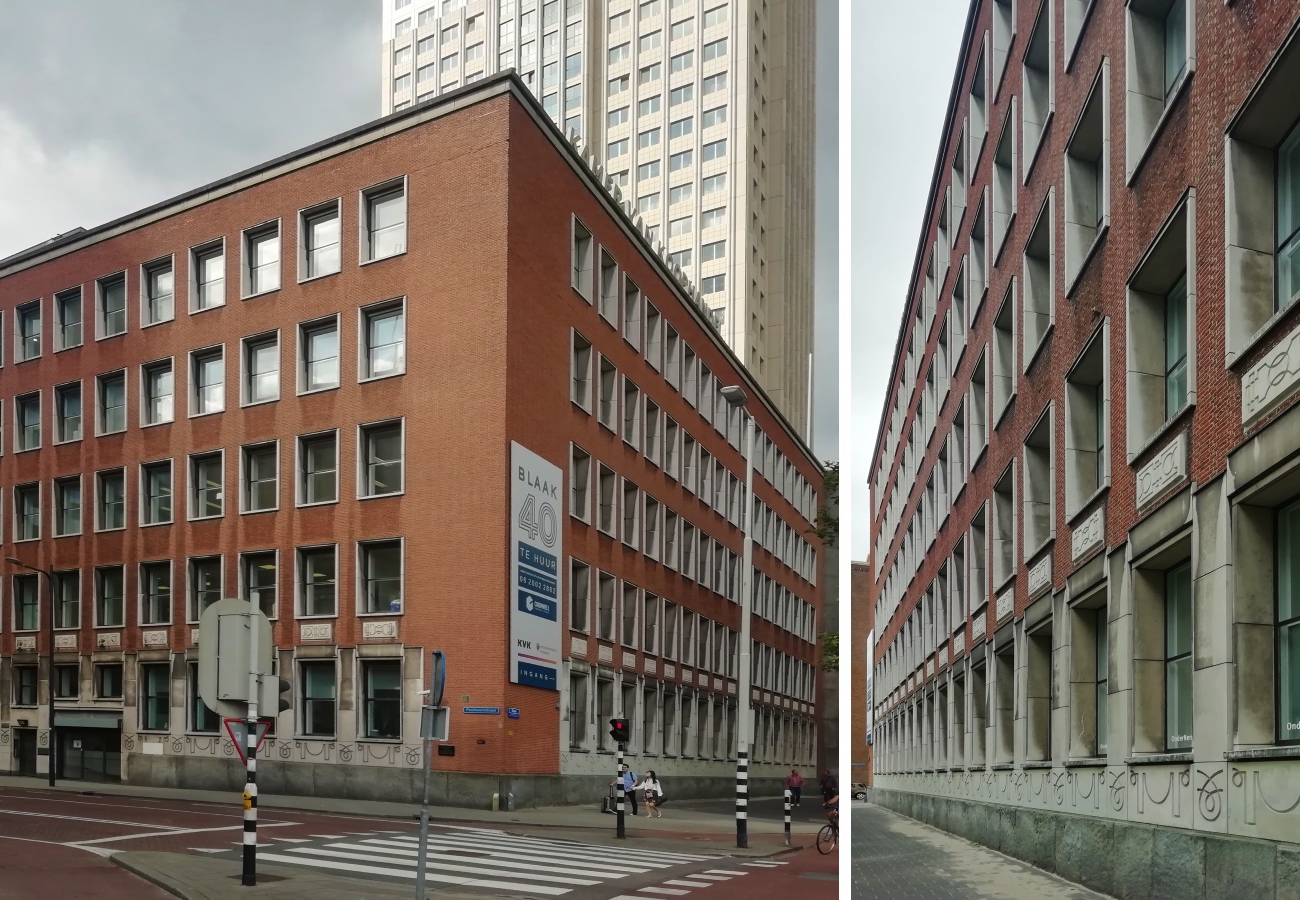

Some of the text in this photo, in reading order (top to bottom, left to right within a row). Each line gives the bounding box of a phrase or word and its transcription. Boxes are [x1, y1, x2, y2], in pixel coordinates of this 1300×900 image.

[518, 465, 558, 500] BLAAK
[518, 493, 558, 549] 40
[520, 547, 556, 571] TE HUUR
[517, 638, 531, 650] KVK
[520, 669, 548, 681] INGANG
